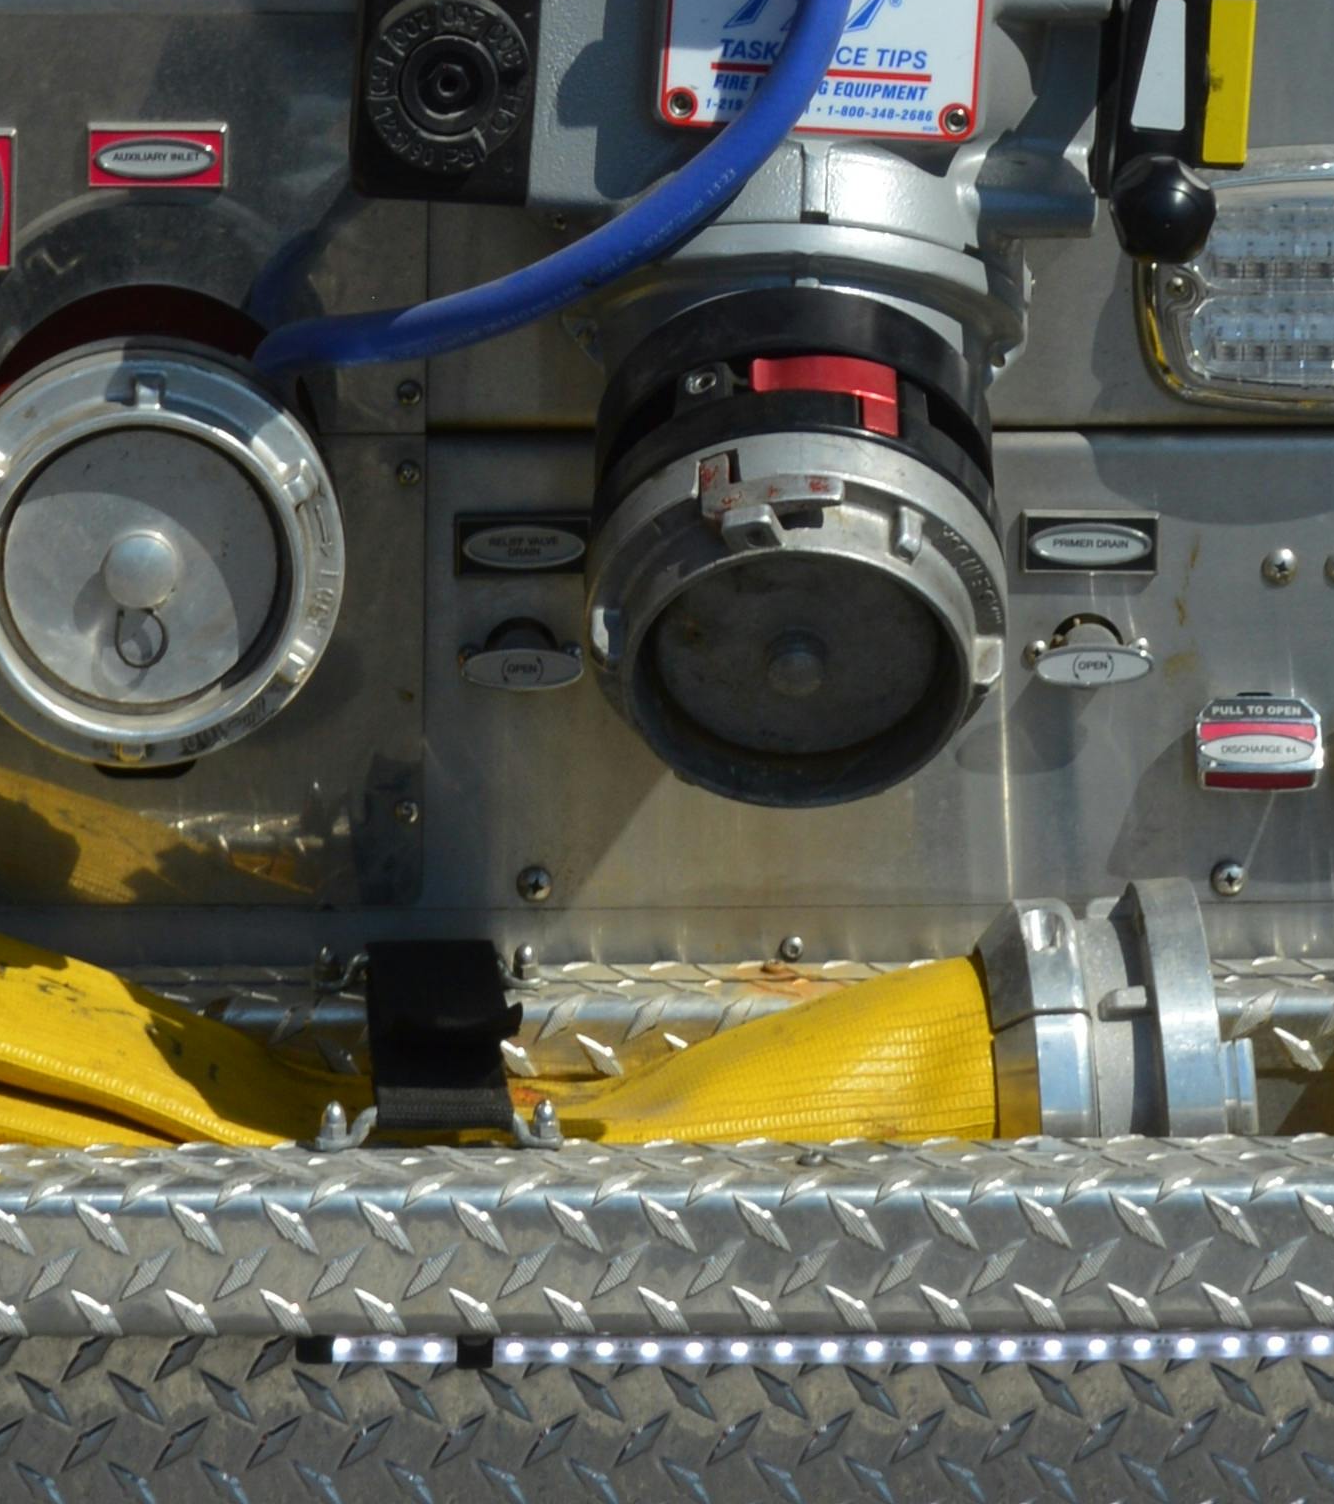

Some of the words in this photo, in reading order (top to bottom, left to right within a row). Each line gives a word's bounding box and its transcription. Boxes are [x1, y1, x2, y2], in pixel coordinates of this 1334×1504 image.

[721, 39, 779, 61] TASK
[876, 48, 928, 70] TIPS
[713, 74, 752, 89] FIRE
[833, 82, 929, 102] EQUIPMENT
[827, 105, 933, 122] 1-800-348-2686
[112, 152, 168, 162] AUXILIARY
[171, 152, 200, 161] INLET
[1053, 539, 1094, 549] PRIMER
[1098, 539, 1129, 549] DRAIN
[507, 663, 537, 673] OPEN
[1078, 661, 1108, 671] OPEN
[1212, 706, 1244, 716] PULL
[1248, 706, 1263, 716] TO
[1267, 706, 1301, 716] OPEN
[1221, 745, 1280, 754] DISCHARGE
[1285, 745, 1297, 754] #4
